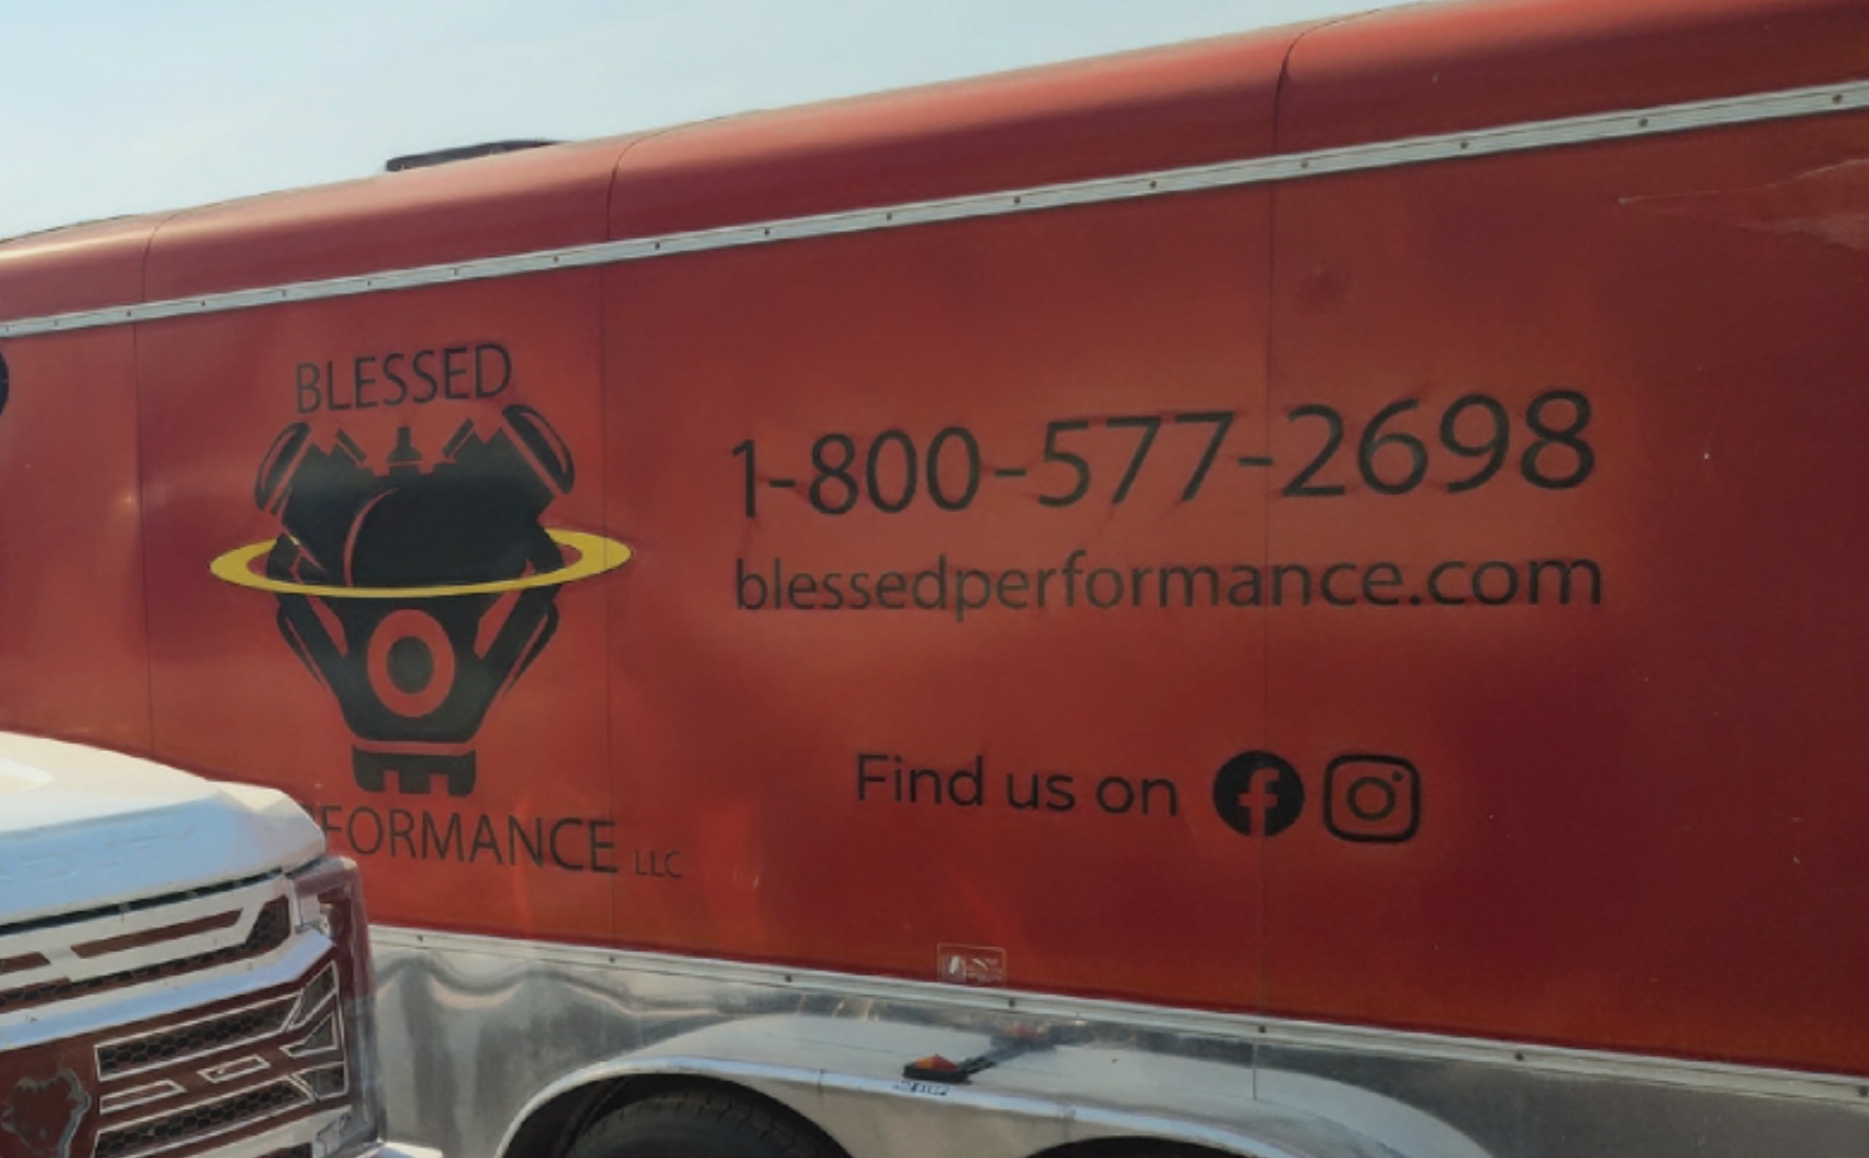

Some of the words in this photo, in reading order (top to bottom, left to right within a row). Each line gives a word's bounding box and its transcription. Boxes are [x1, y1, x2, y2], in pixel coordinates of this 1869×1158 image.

[296, 342, 512, 414] BLESSED
[730, 389, 1597, 519] 1-800-577-2698
[736, 549, 1603, 621] blessedperformance.com
[855, 753, 985, 808] Find
[1006, 771, 1077, 813] us
[1096, 774, 1179, 818] on
[302, 804, 619, 874] FORMANCE
[635, 849, 684, 879] LLC
